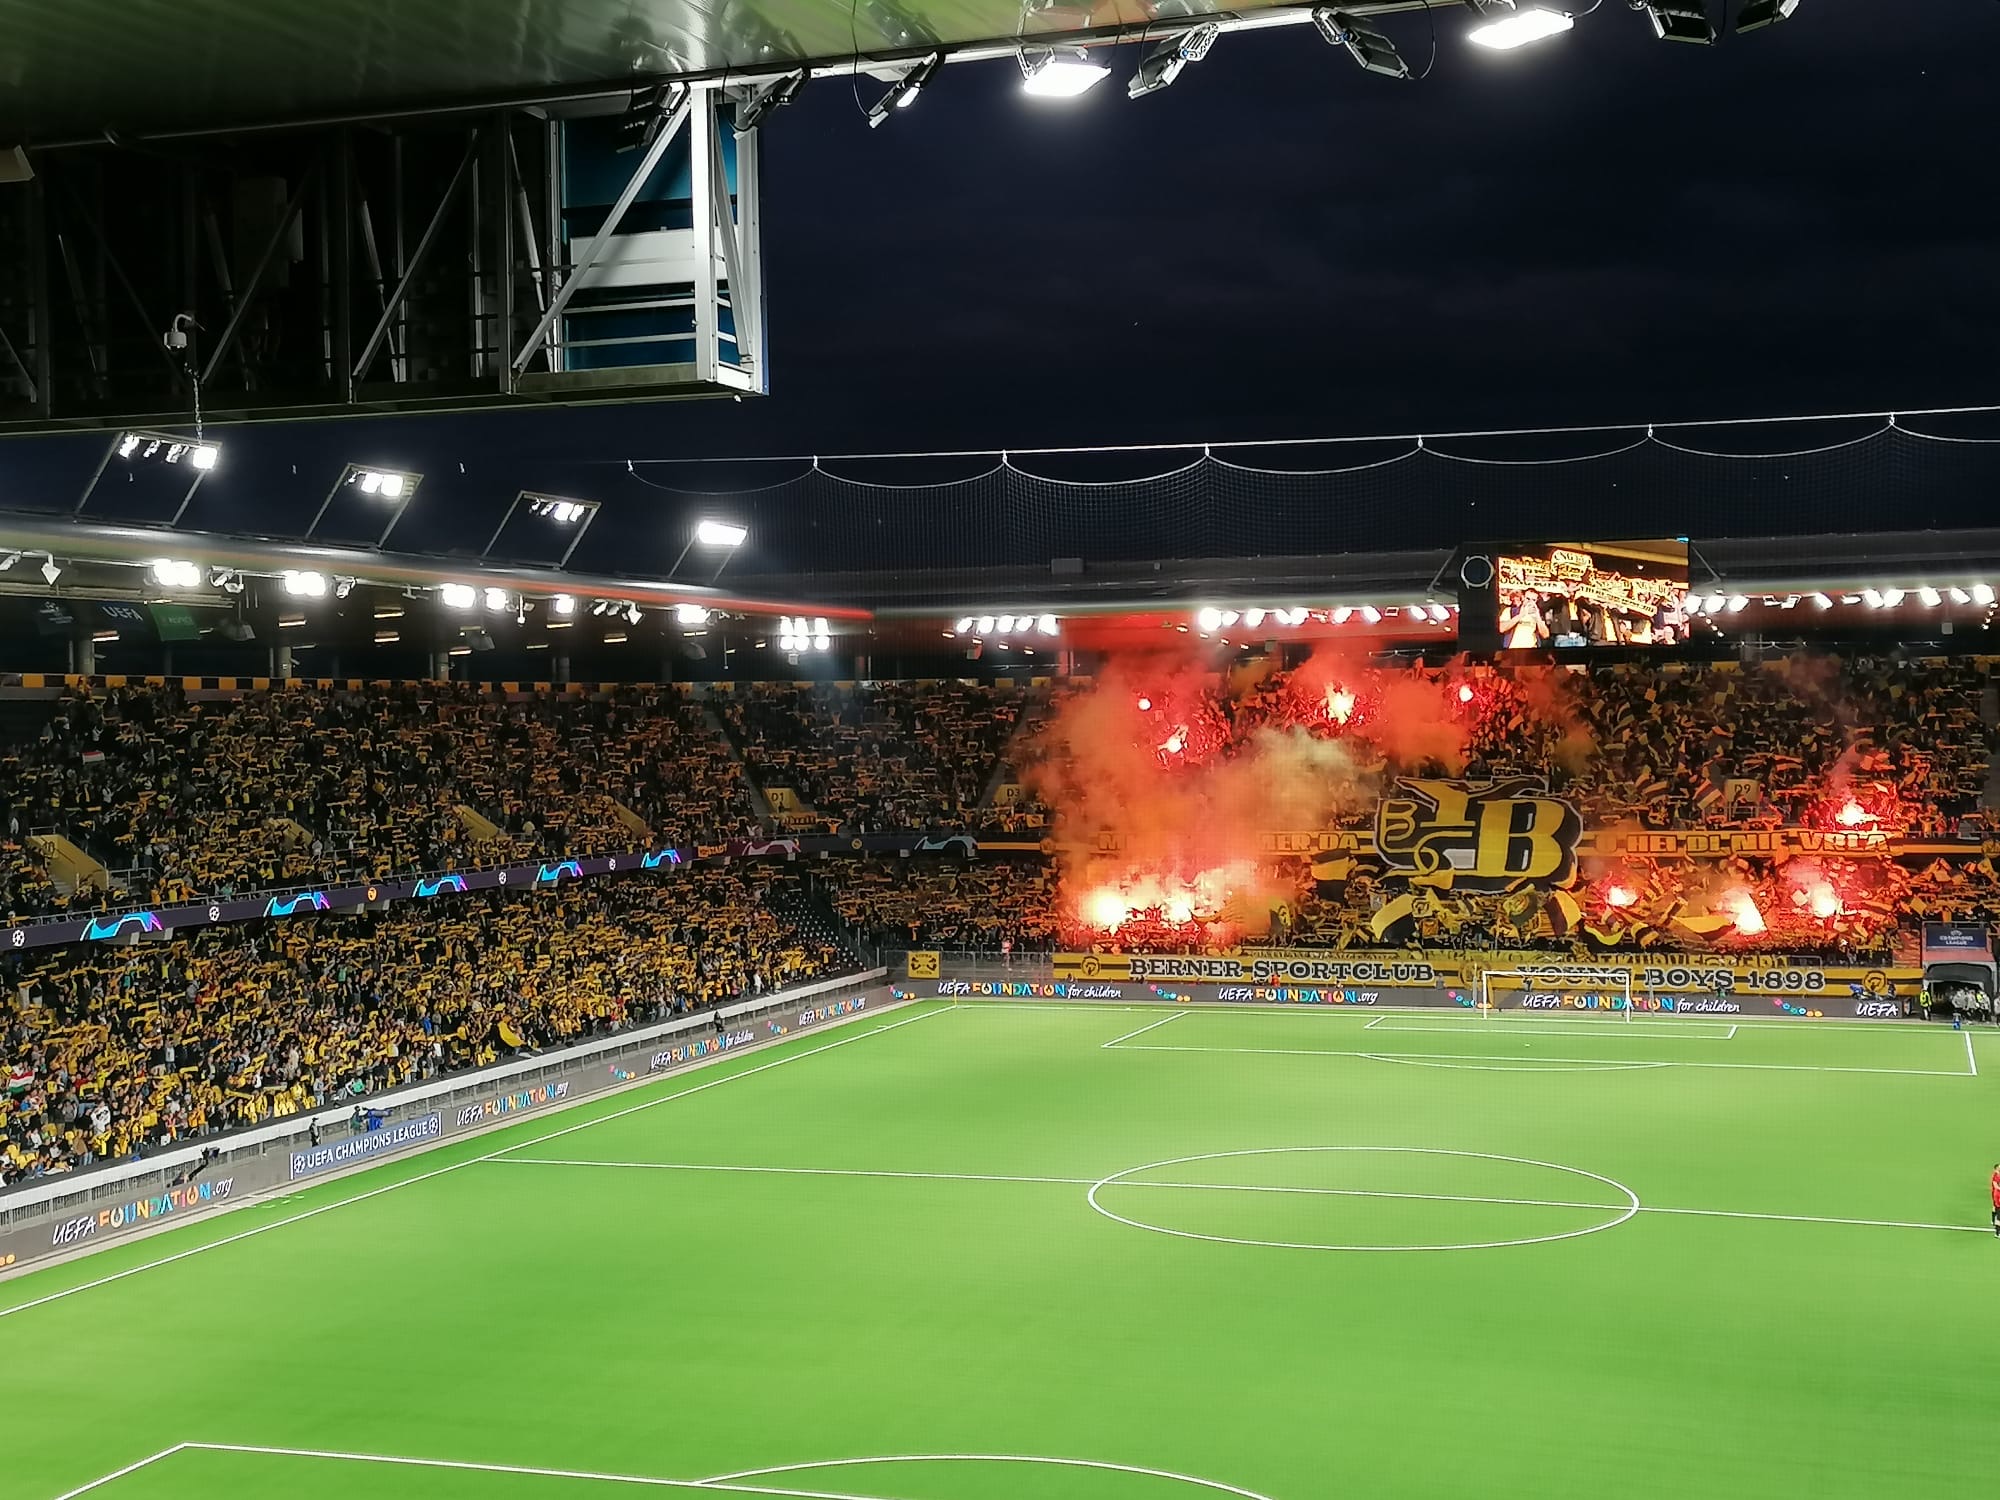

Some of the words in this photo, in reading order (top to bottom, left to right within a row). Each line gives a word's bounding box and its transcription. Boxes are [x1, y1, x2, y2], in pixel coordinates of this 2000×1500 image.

[102, 606, 143, 621] UEFA
[1130, 958, 1242, 978] BERNER
[1253, 960, 1434, 982] SPORTCLUB
[1517, 965, 1631, 986] YOUNG
[1645, 967, 1734, 990] BOYS
[1749, 969, 1825, 990] 1898
[937, 981, 971, 994] UEFA
[972, 982, 1066, 997] FOUNDATION
[1067, 983, 1082, 999] for
[1083, 985, 1121, 998] children
[1218, 988, 1253, 1001] UEFA
[1522, 993, 1561, 1008] UEFA
[1563, 994, 1673, 1013] FOUNDATION
[1676, 998, 1695, 1015] for
[1695, 999, 1740, 1014] children
[1856, 1002, 1898, 1016] UEFA
[799, 1010, 815, 1026] UEFA
[651, 1051, 671, 1069] UEFA
[671, 1034, 725, 1062] FOUNDATION
[456, 1105, 484, 1126] UEFA
[307, 1150, 334, 1169] UEFA
[335, 1131, 391, 1161] CHAMPIONS
[393, 1121, 428, 1141] LEAGUE
[52, 1215, 97, 1246] UEFA
